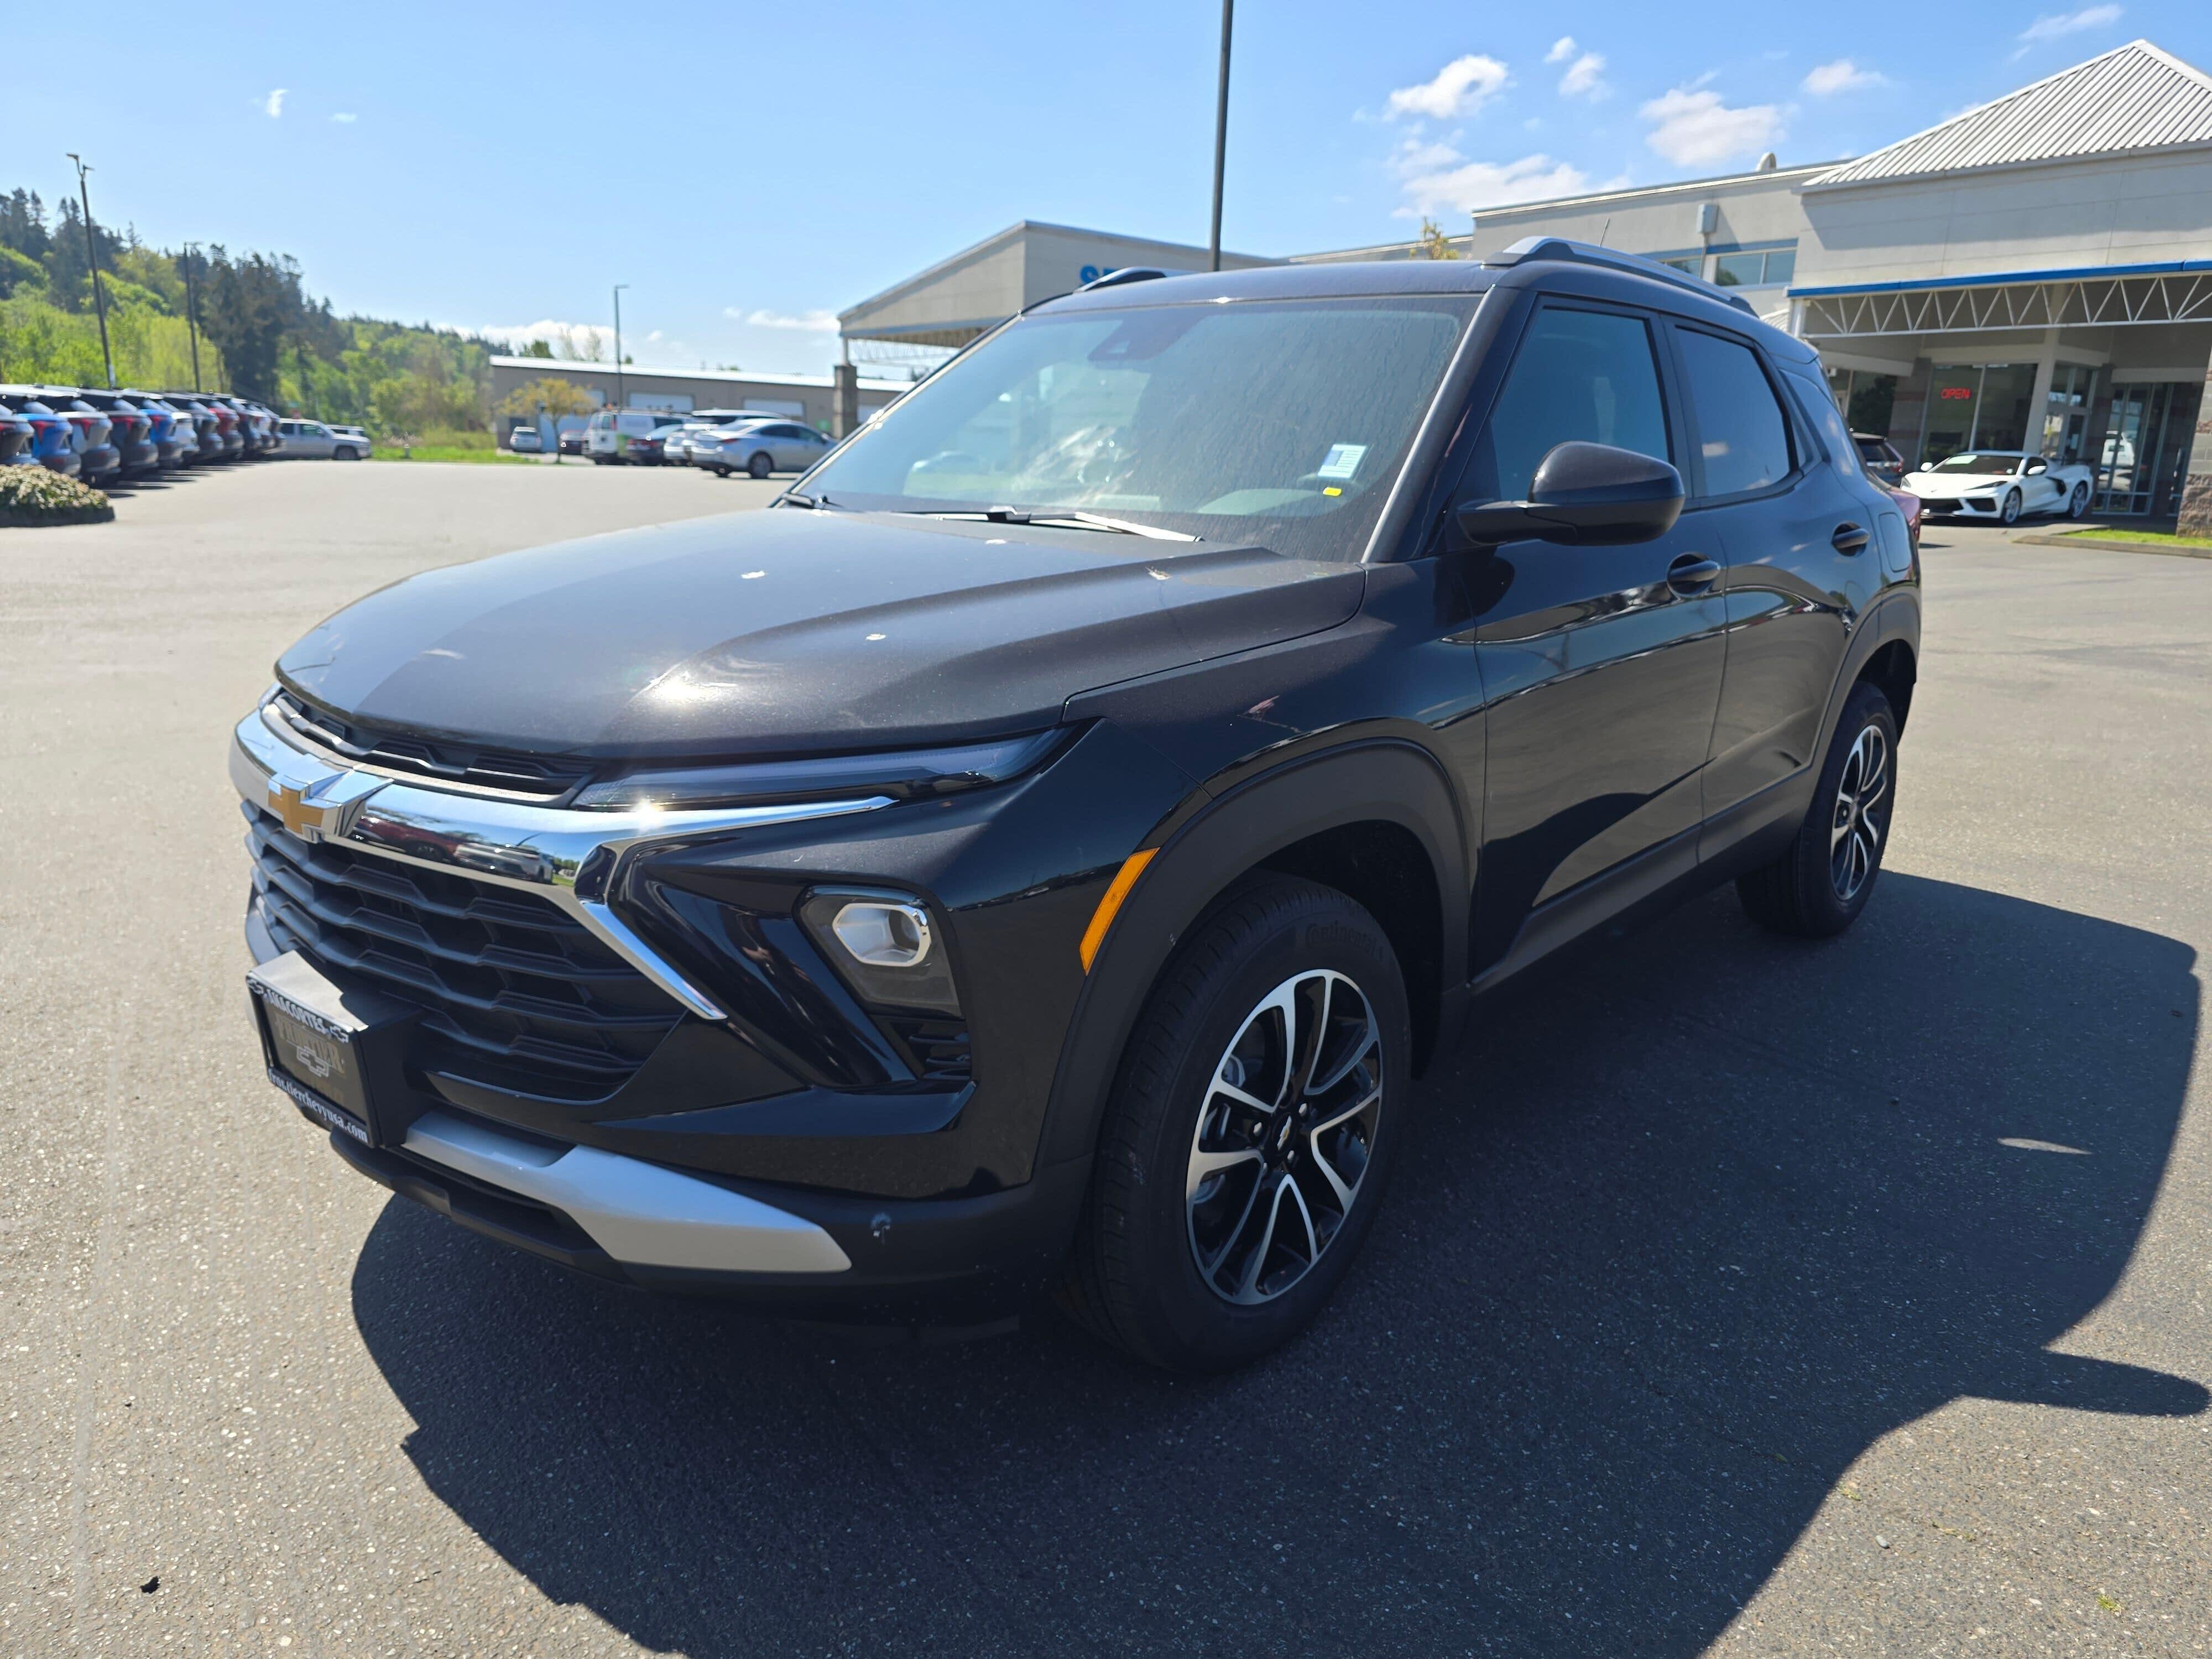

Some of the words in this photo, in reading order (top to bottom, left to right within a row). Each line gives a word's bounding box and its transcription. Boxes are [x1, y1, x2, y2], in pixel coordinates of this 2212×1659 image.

[1941, 388, 1970, 399] OPEN
[1306, 922, 1376, 957] Continental
[264, 988, 325, 1034] ANACORTES
[268, 1068, 368, 1144] frontierchevyusa.com
